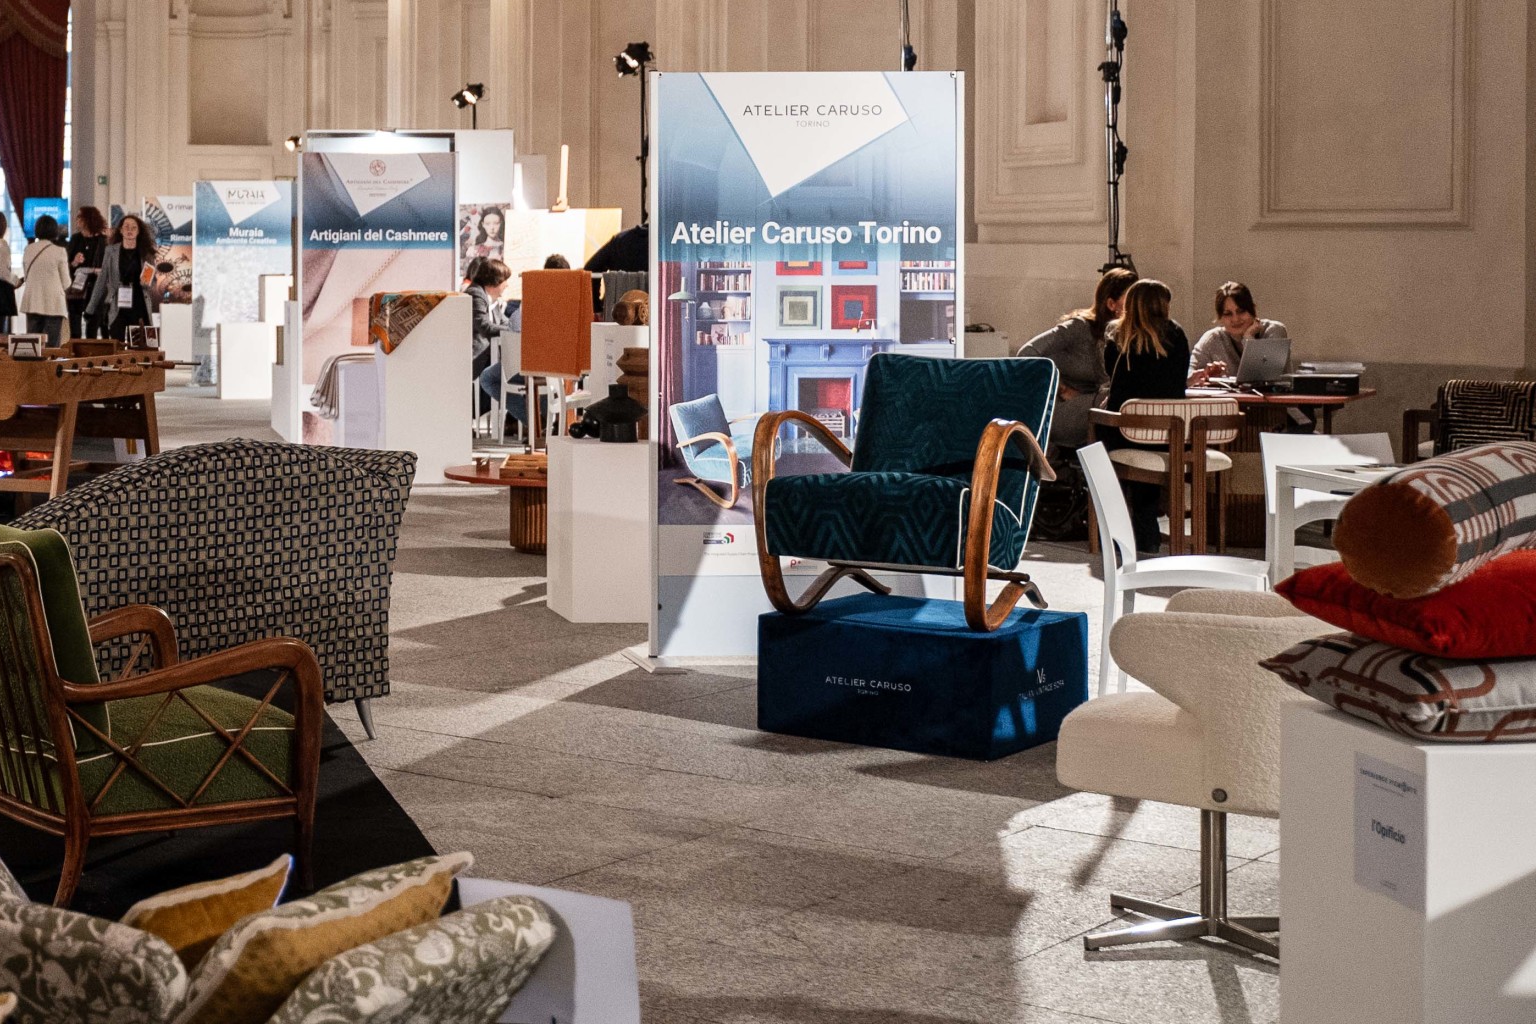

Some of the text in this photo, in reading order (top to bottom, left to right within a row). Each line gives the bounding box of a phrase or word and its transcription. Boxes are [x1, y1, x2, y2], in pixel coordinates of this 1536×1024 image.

[743, 105, 883, 116] ATELIER CARUSO
[796, 120, 830, 128] TORINO
[228, 226, 264, 237] Muraia
[309, 228, 448, 243] Artigiani del Cashmere
[670, 220, 942, 244] Atelier Caruso Torino
[825, 675, 912, 692] ATELIER CARUSO
